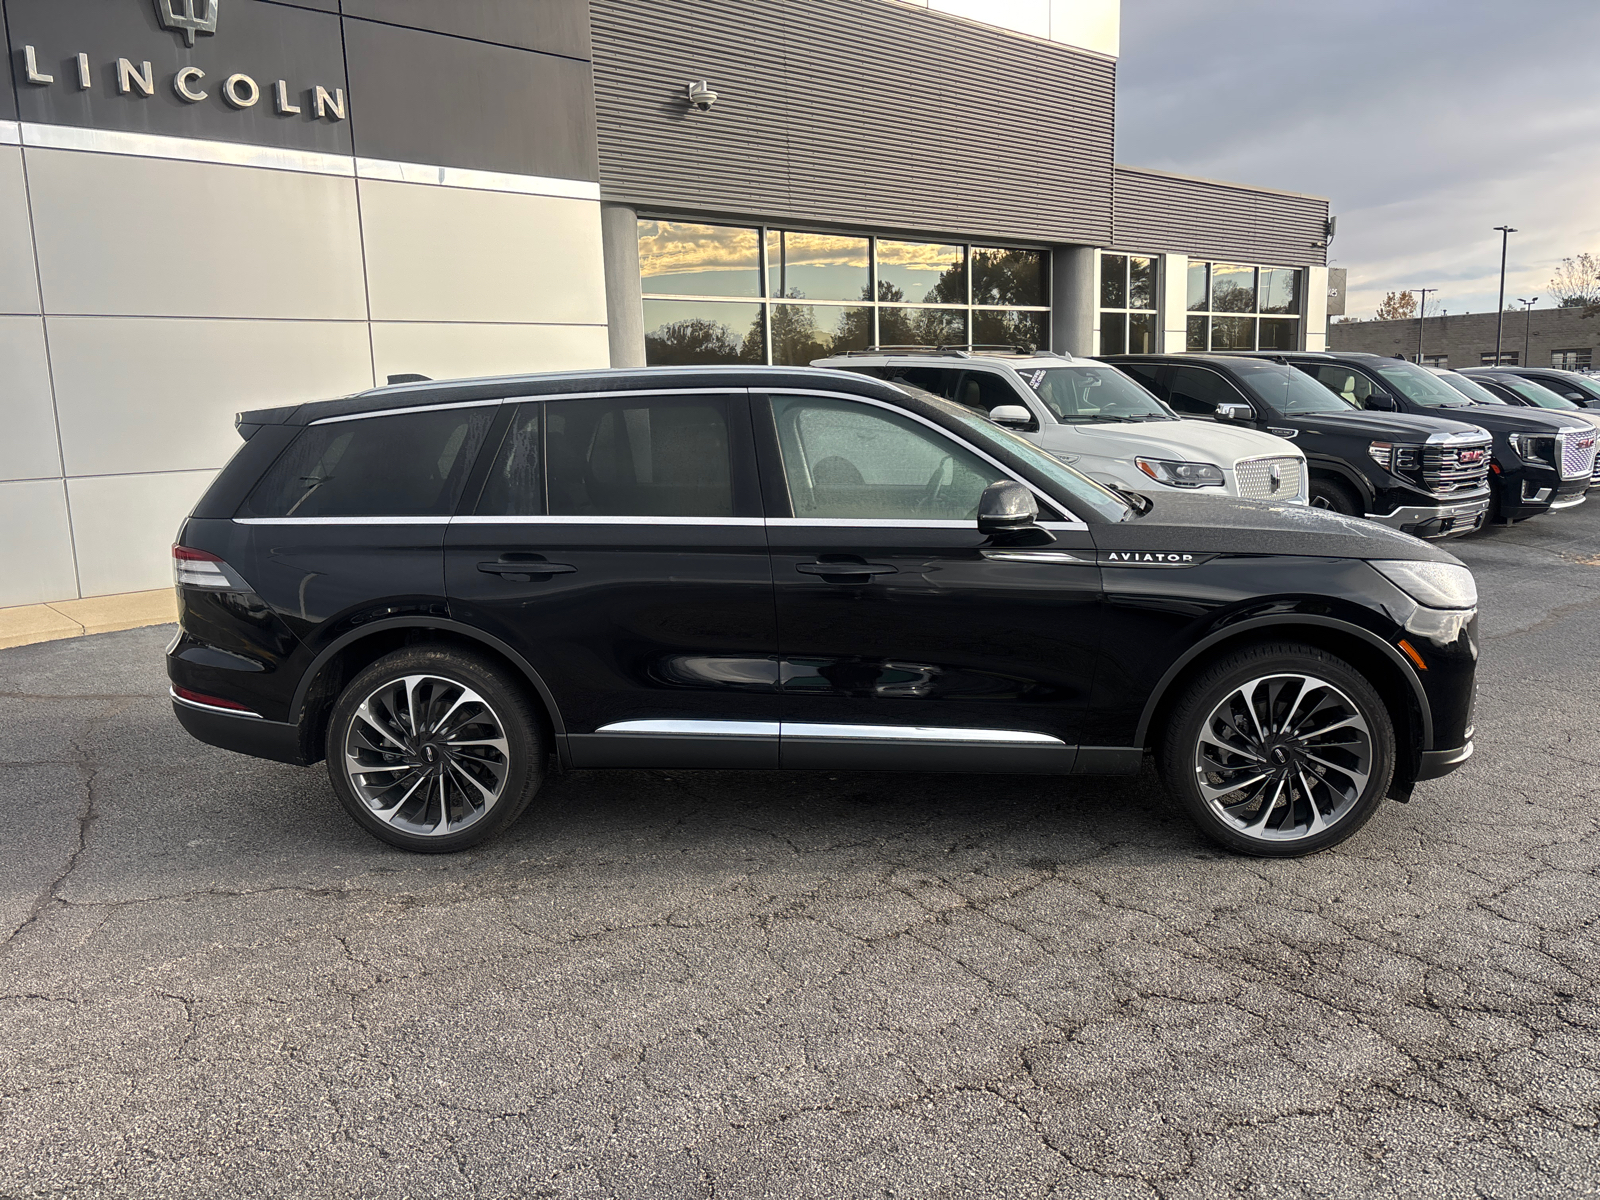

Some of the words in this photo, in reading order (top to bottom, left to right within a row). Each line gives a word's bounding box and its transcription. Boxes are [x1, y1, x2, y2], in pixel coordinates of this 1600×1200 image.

[24, 45, 346, 120] LINCOLN
[1460, 450, 1484, 462] GMC
[1108, 552, 1193, 562] AVIATOR
